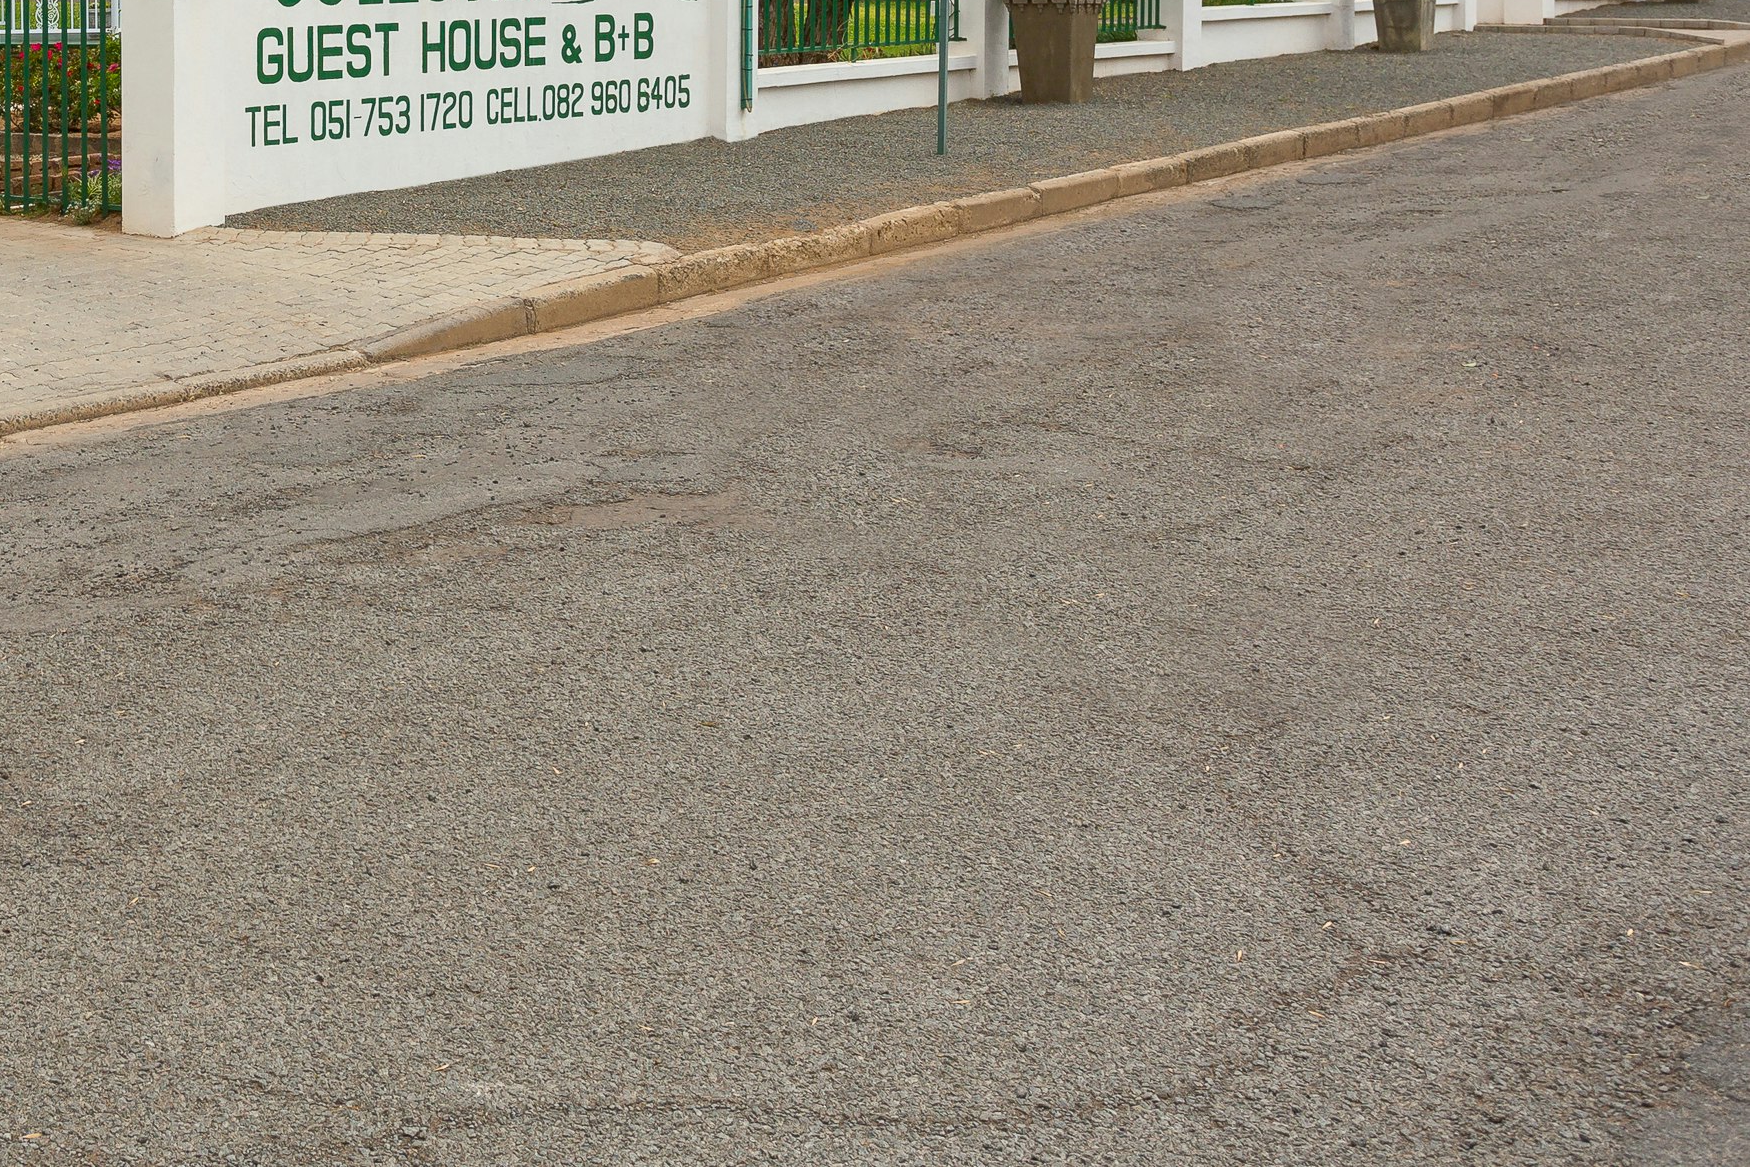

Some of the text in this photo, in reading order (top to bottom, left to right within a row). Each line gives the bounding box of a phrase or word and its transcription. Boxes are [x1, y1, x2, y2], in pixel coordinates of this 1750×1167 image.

[257, 12, 654, 84] GUEST HOUSE & B+B
[246, 105, 298, 147] TEL
[310, 96, 411, 141] 051-753
[420, 91, 473, 131] 1720
[591, 81, 630, 114] 960
[637, 74, 691, 112] 6405
